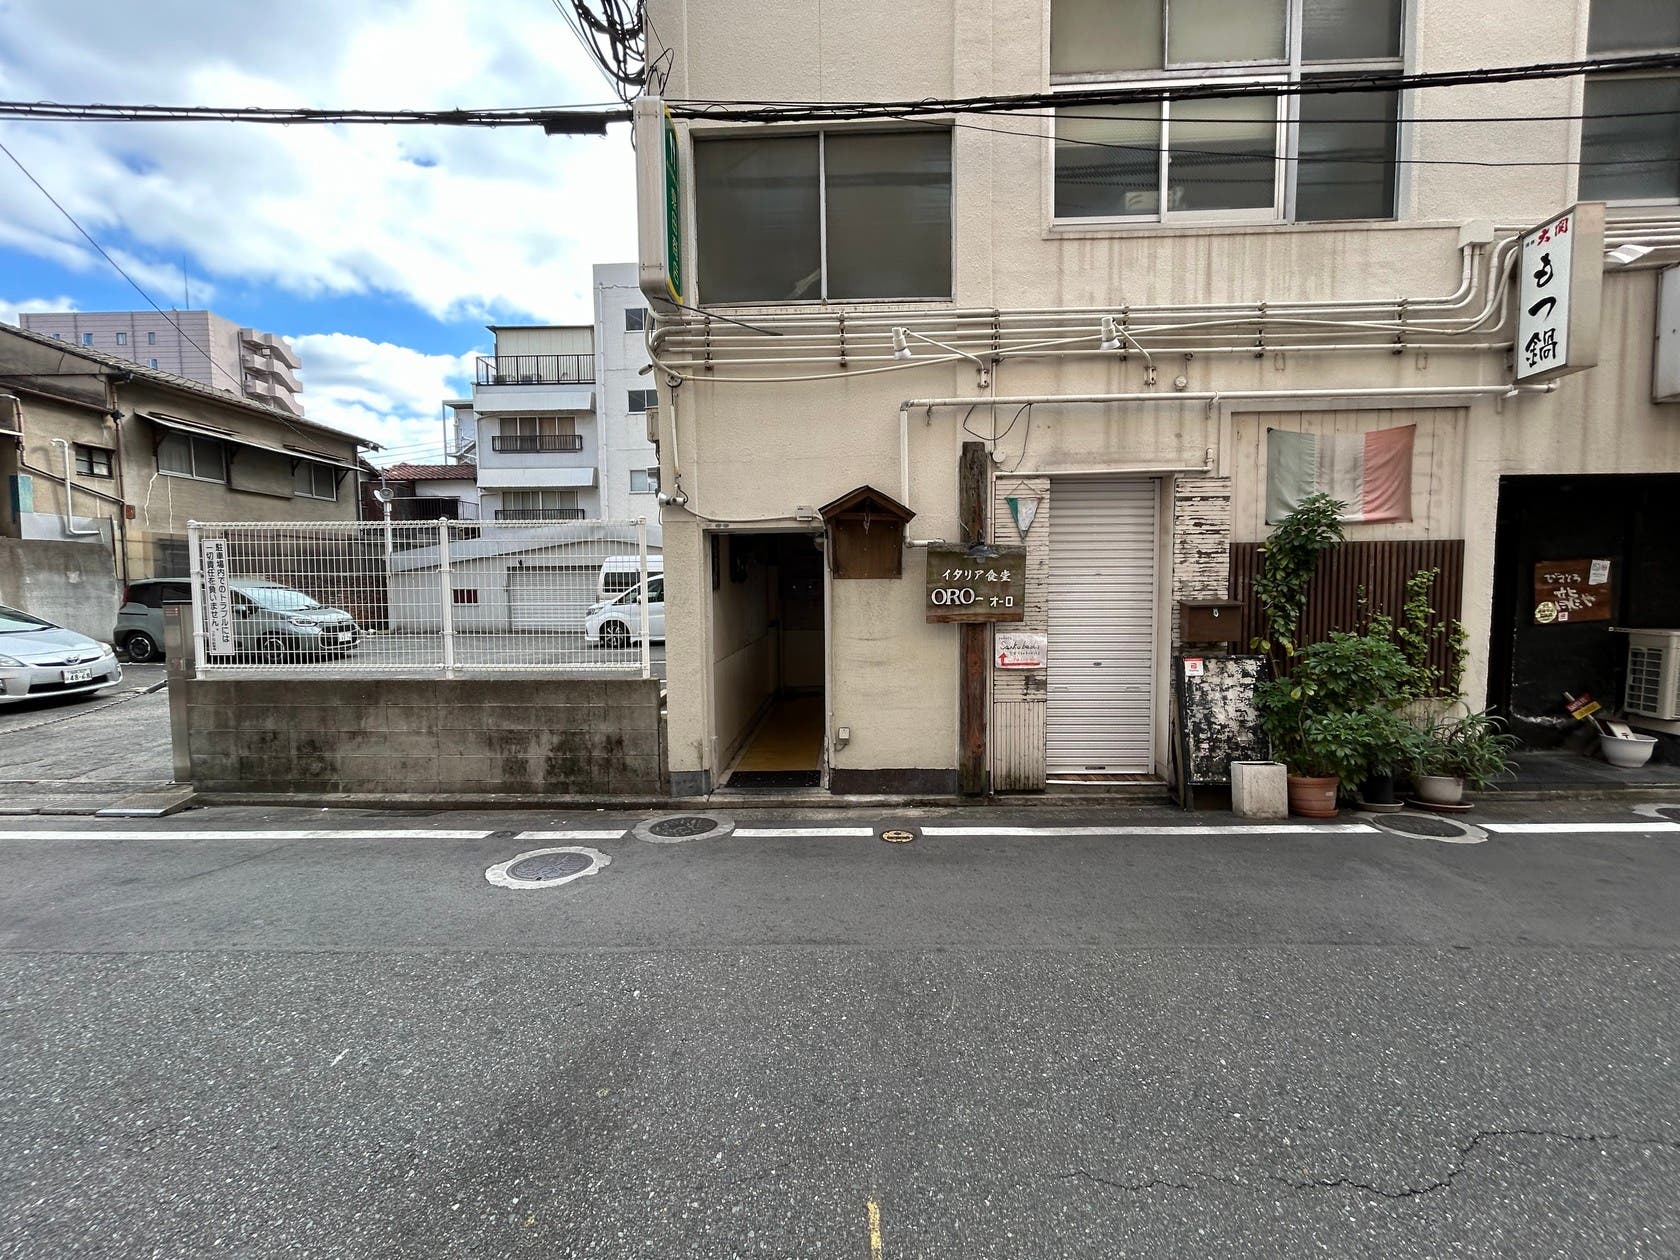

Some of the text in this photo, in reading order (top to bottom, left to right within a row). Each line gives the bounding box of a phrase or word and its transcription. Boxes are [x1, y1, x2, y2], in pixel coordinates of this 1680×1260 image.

[1525, 252, 1558, 368] もつ鍋
[942, 568, 1012, 582] イタリア食堂
